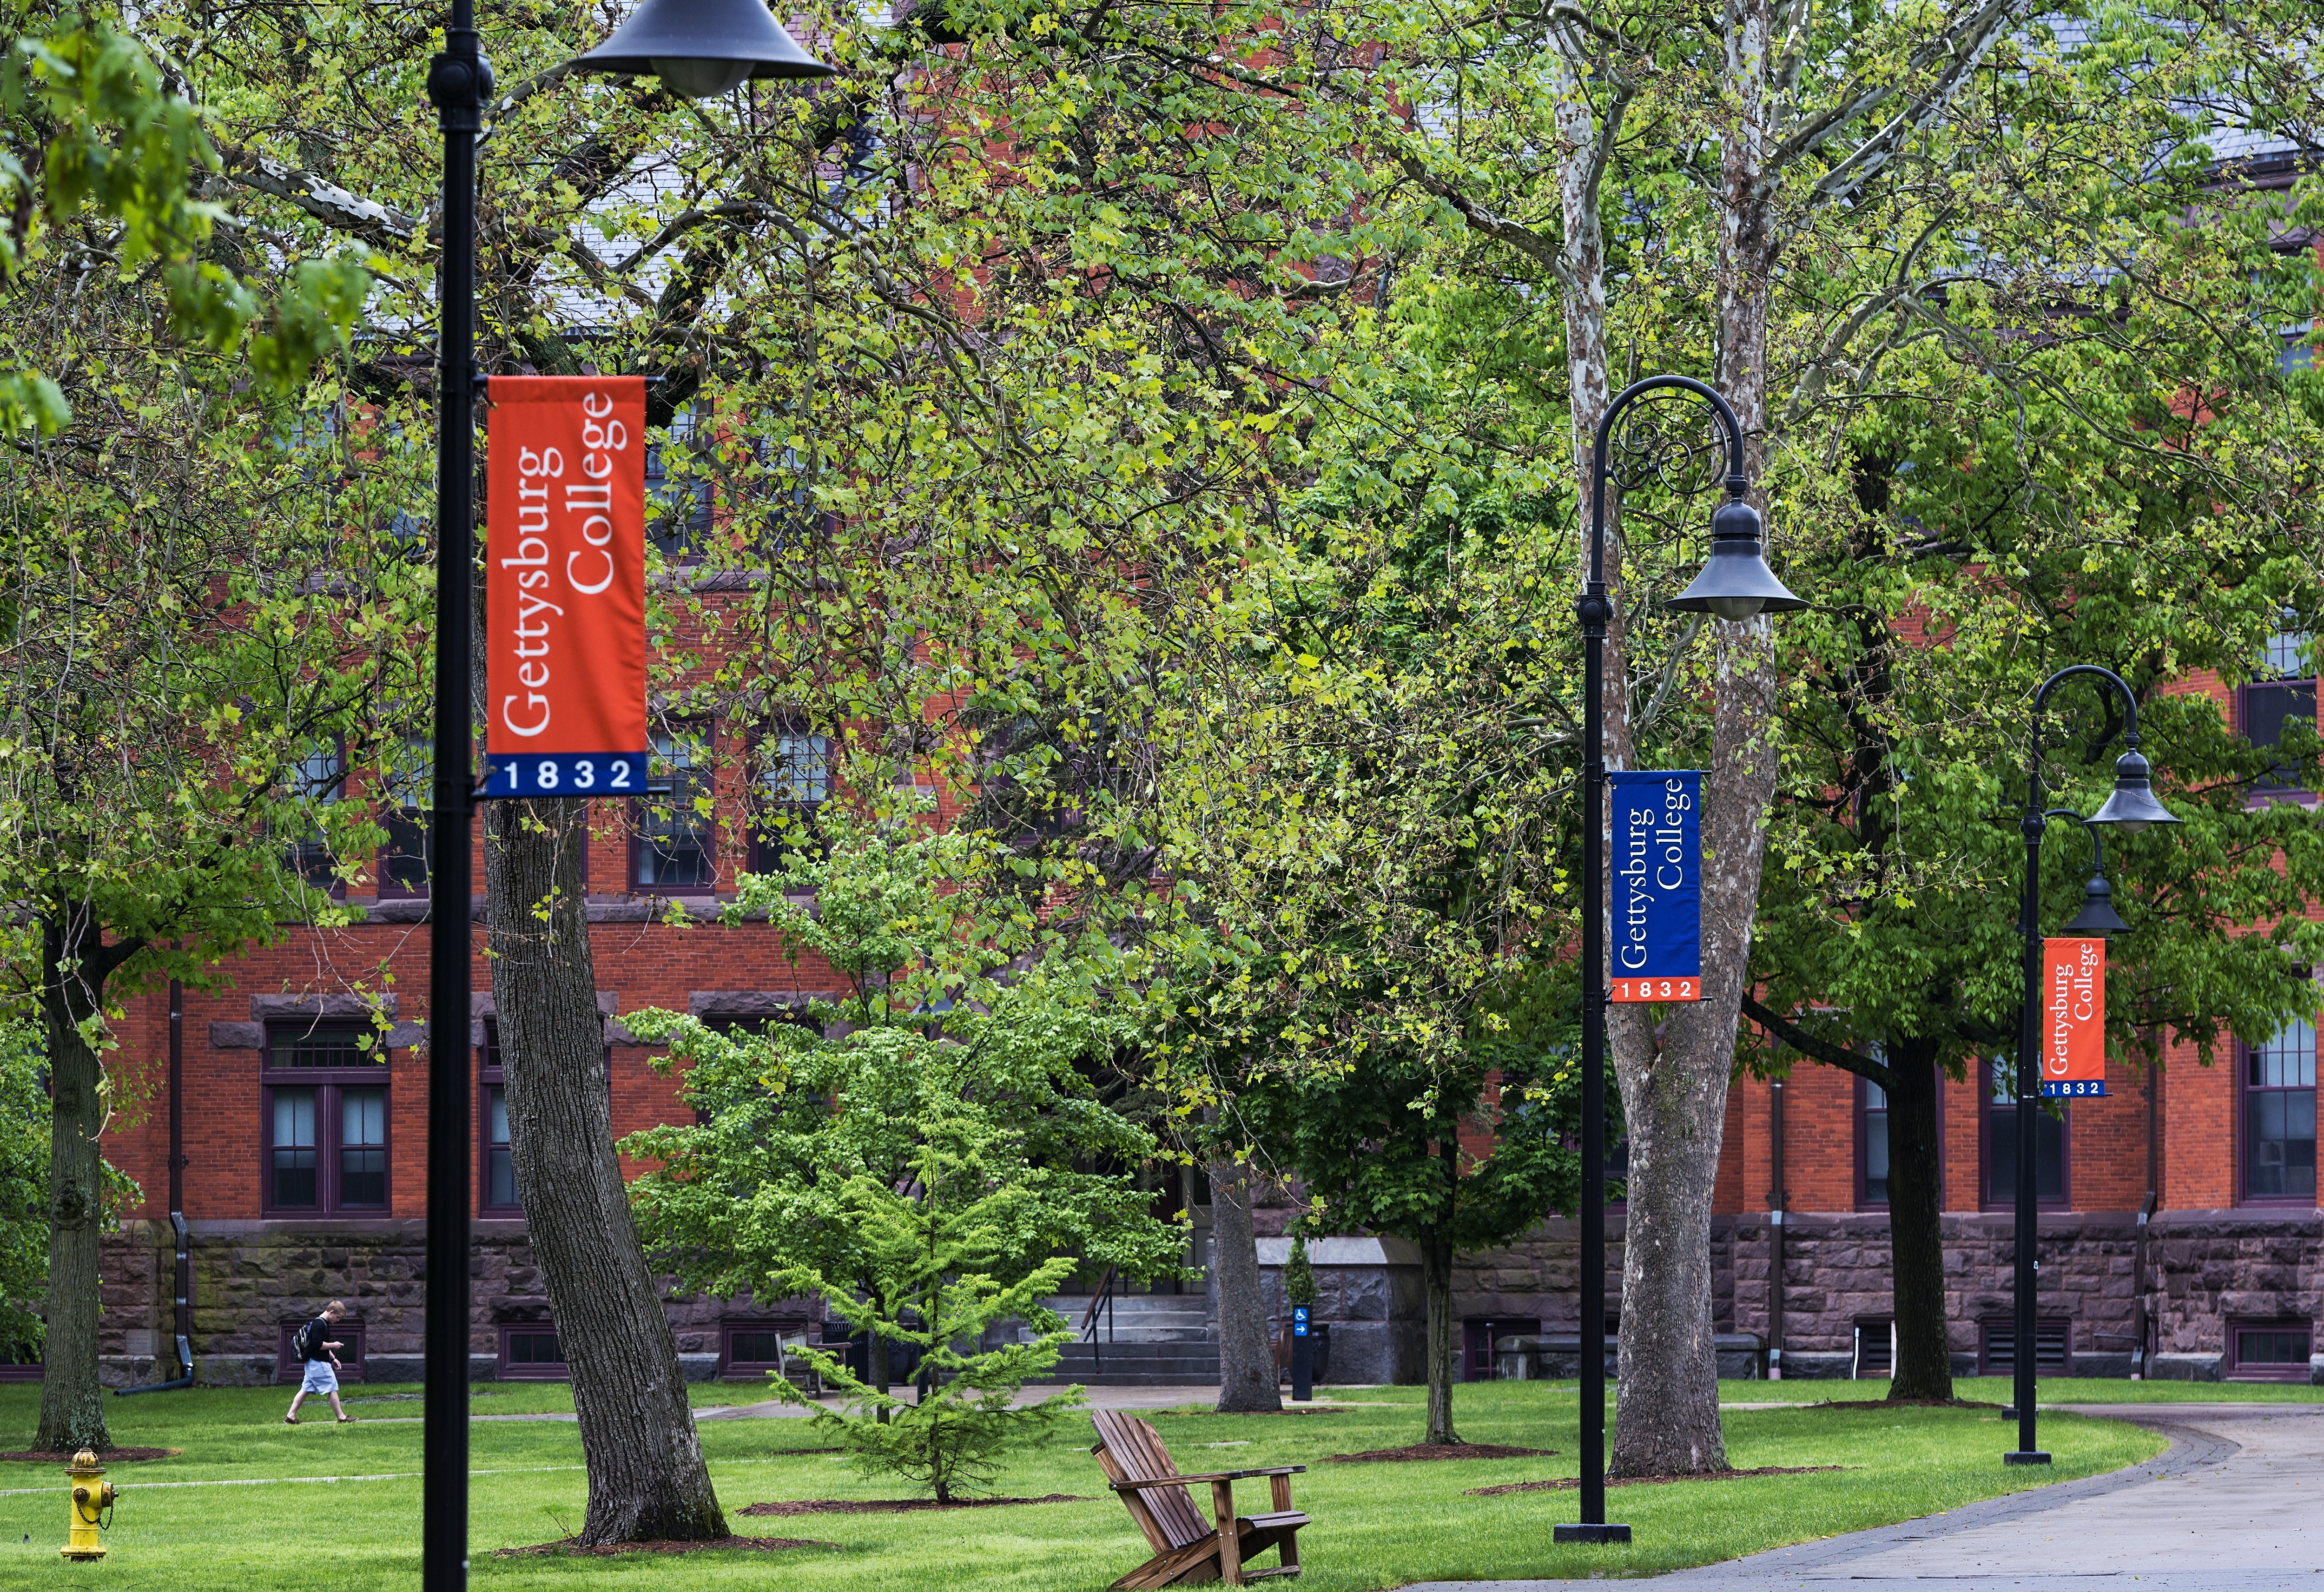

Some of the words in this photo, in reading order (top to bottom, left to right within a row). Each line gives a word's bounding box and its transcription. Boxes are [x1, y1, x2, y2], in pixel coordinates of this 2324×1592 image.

[565, 392, 627, 595] College
[501, 446, 564, 737] Gettysburg
[505, 760, 630, 789] 1832
[1620, 808, 1655, 969] Gettysburg
[1656, 779, 1690, 890] College
[1621, 981, 1691, 998] 1832
[2049, 964, 2074, 1075] Gettysburg
[2073, 943, 2099, 1021] College
[2050, 1082, 2099, 1095] 1832
